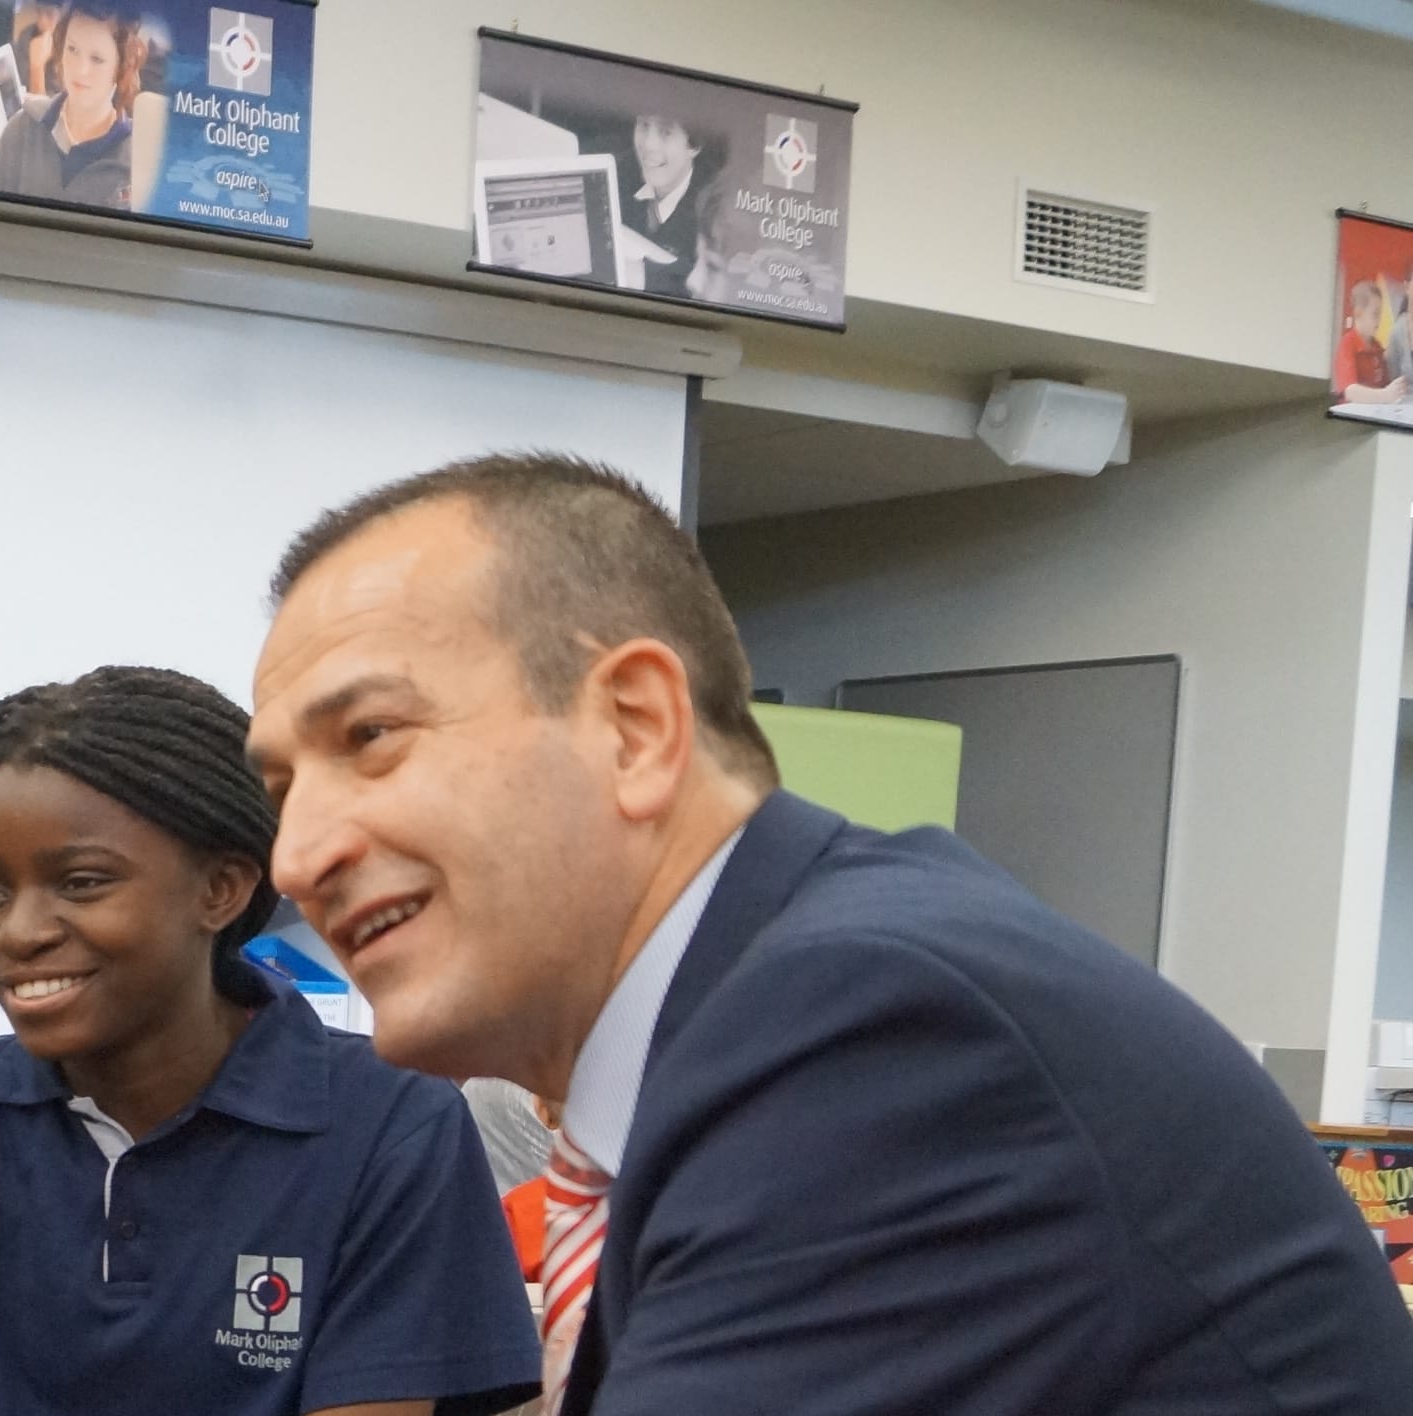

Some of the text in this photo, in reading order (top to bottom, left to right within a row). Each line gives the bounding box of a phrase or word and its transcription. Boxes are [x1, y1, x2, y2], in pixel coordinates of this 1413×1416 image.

[175, 90, 300, 133] Mark Oliphant
[206, 121, 269, 157] College
[216, 170, 257, 190] aspire
[179, 200, 289, 228] www.moc.sa.edu.au
[736, 189, 839, 227] Mark Oliphant
[760, 217, 814, 249] College
[215, 1328, 254, 1349] Mark
[238, 1350, 291, 1372] College
